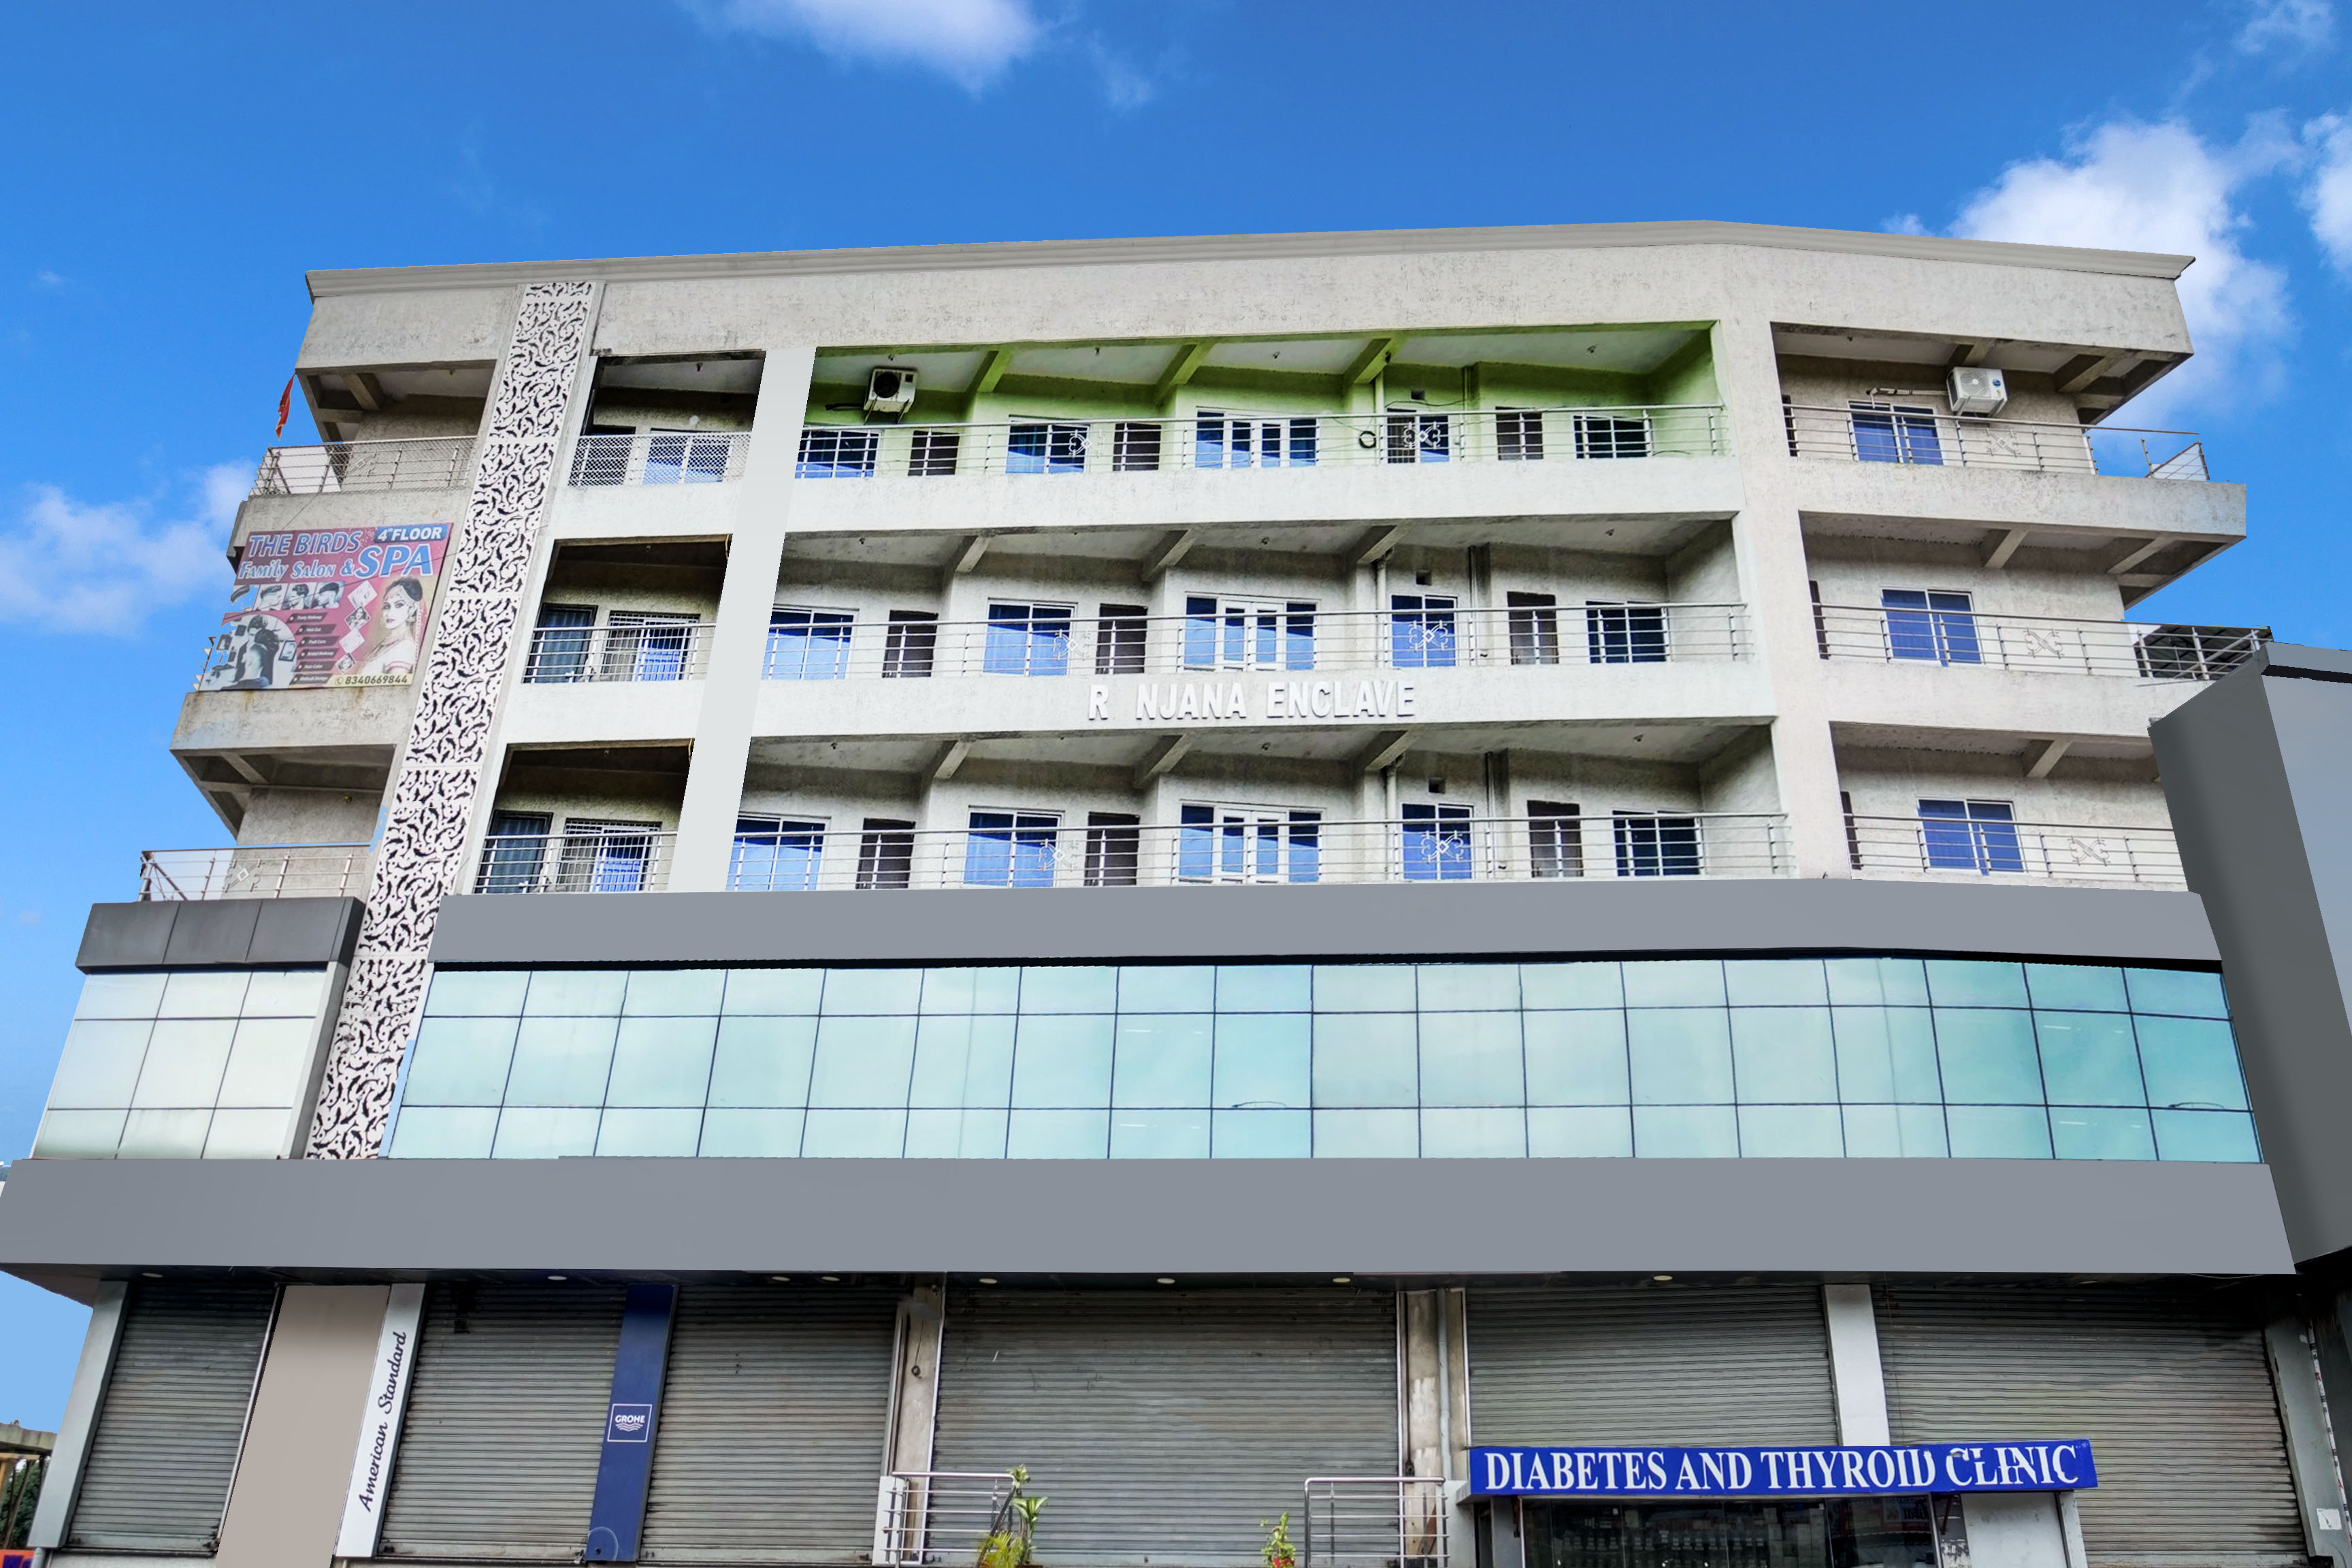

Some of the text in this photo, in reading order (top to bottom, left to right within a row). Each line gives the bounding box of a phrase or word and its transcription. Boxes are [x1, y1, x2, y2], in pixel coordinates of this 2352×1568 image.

[249, 531, 363, 557] THE BIRDS
[391, 527, 442, 541] FLOOR
[340, 558, 355, 576] &
[354, 544, 434, 578] SPA
[345, 675, 408, 685] 8340669844
[1267, 680, 1416, 719] ENCLAVE
[359, 1331, 407, 1513] American Standard
[615, 1414, 646, 1424] GROHE
[1485, 1443, 2079, 1491] DIABETES AND THYROID CLINIC
